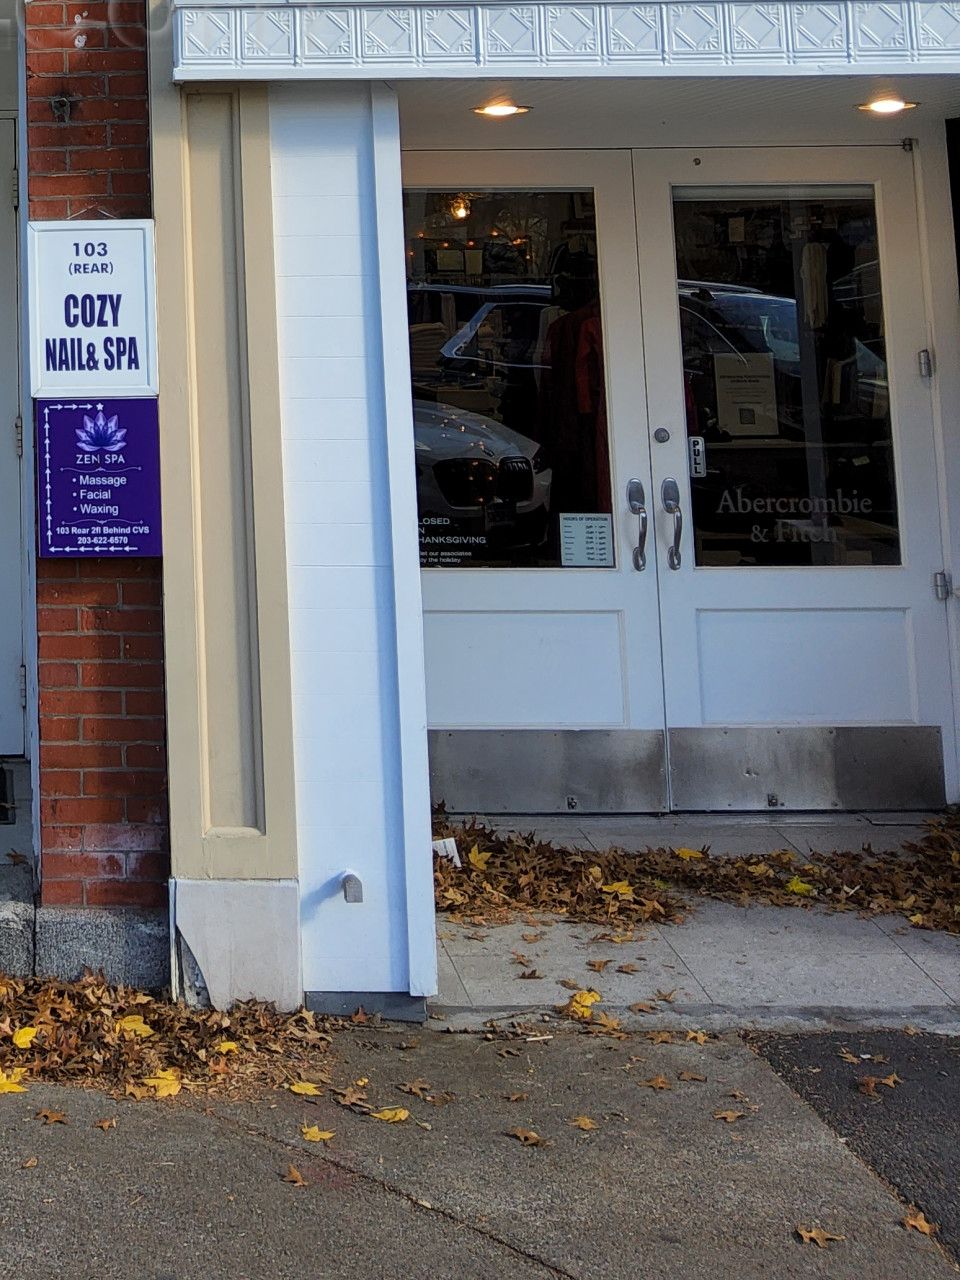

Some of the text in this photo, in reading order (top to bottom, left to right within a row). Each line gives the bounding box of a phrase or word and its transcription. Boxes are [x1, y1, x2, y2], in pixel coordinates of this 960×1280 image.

[73, 242, 108, 257] 103
[68, 261, 114, 275] (REAR)
[64, 293, 122, 328] COZY
[45, 336, 140, 371] NAIL& SPA
[76, 454, 126, 464] ZEN SPA
[692, 439, 702, 475] PULL
[79, 475, 127, 487] Massage
[80, 489, 111, 499] Facial
[717, 488, 872, 513] Abercrombie
[80, 504, 119, 515] Waxing
[103, 526, 130, 534] Behind
[132, 526, 150, 534] CVS
[751, 518, 839, 543] & Fitch
